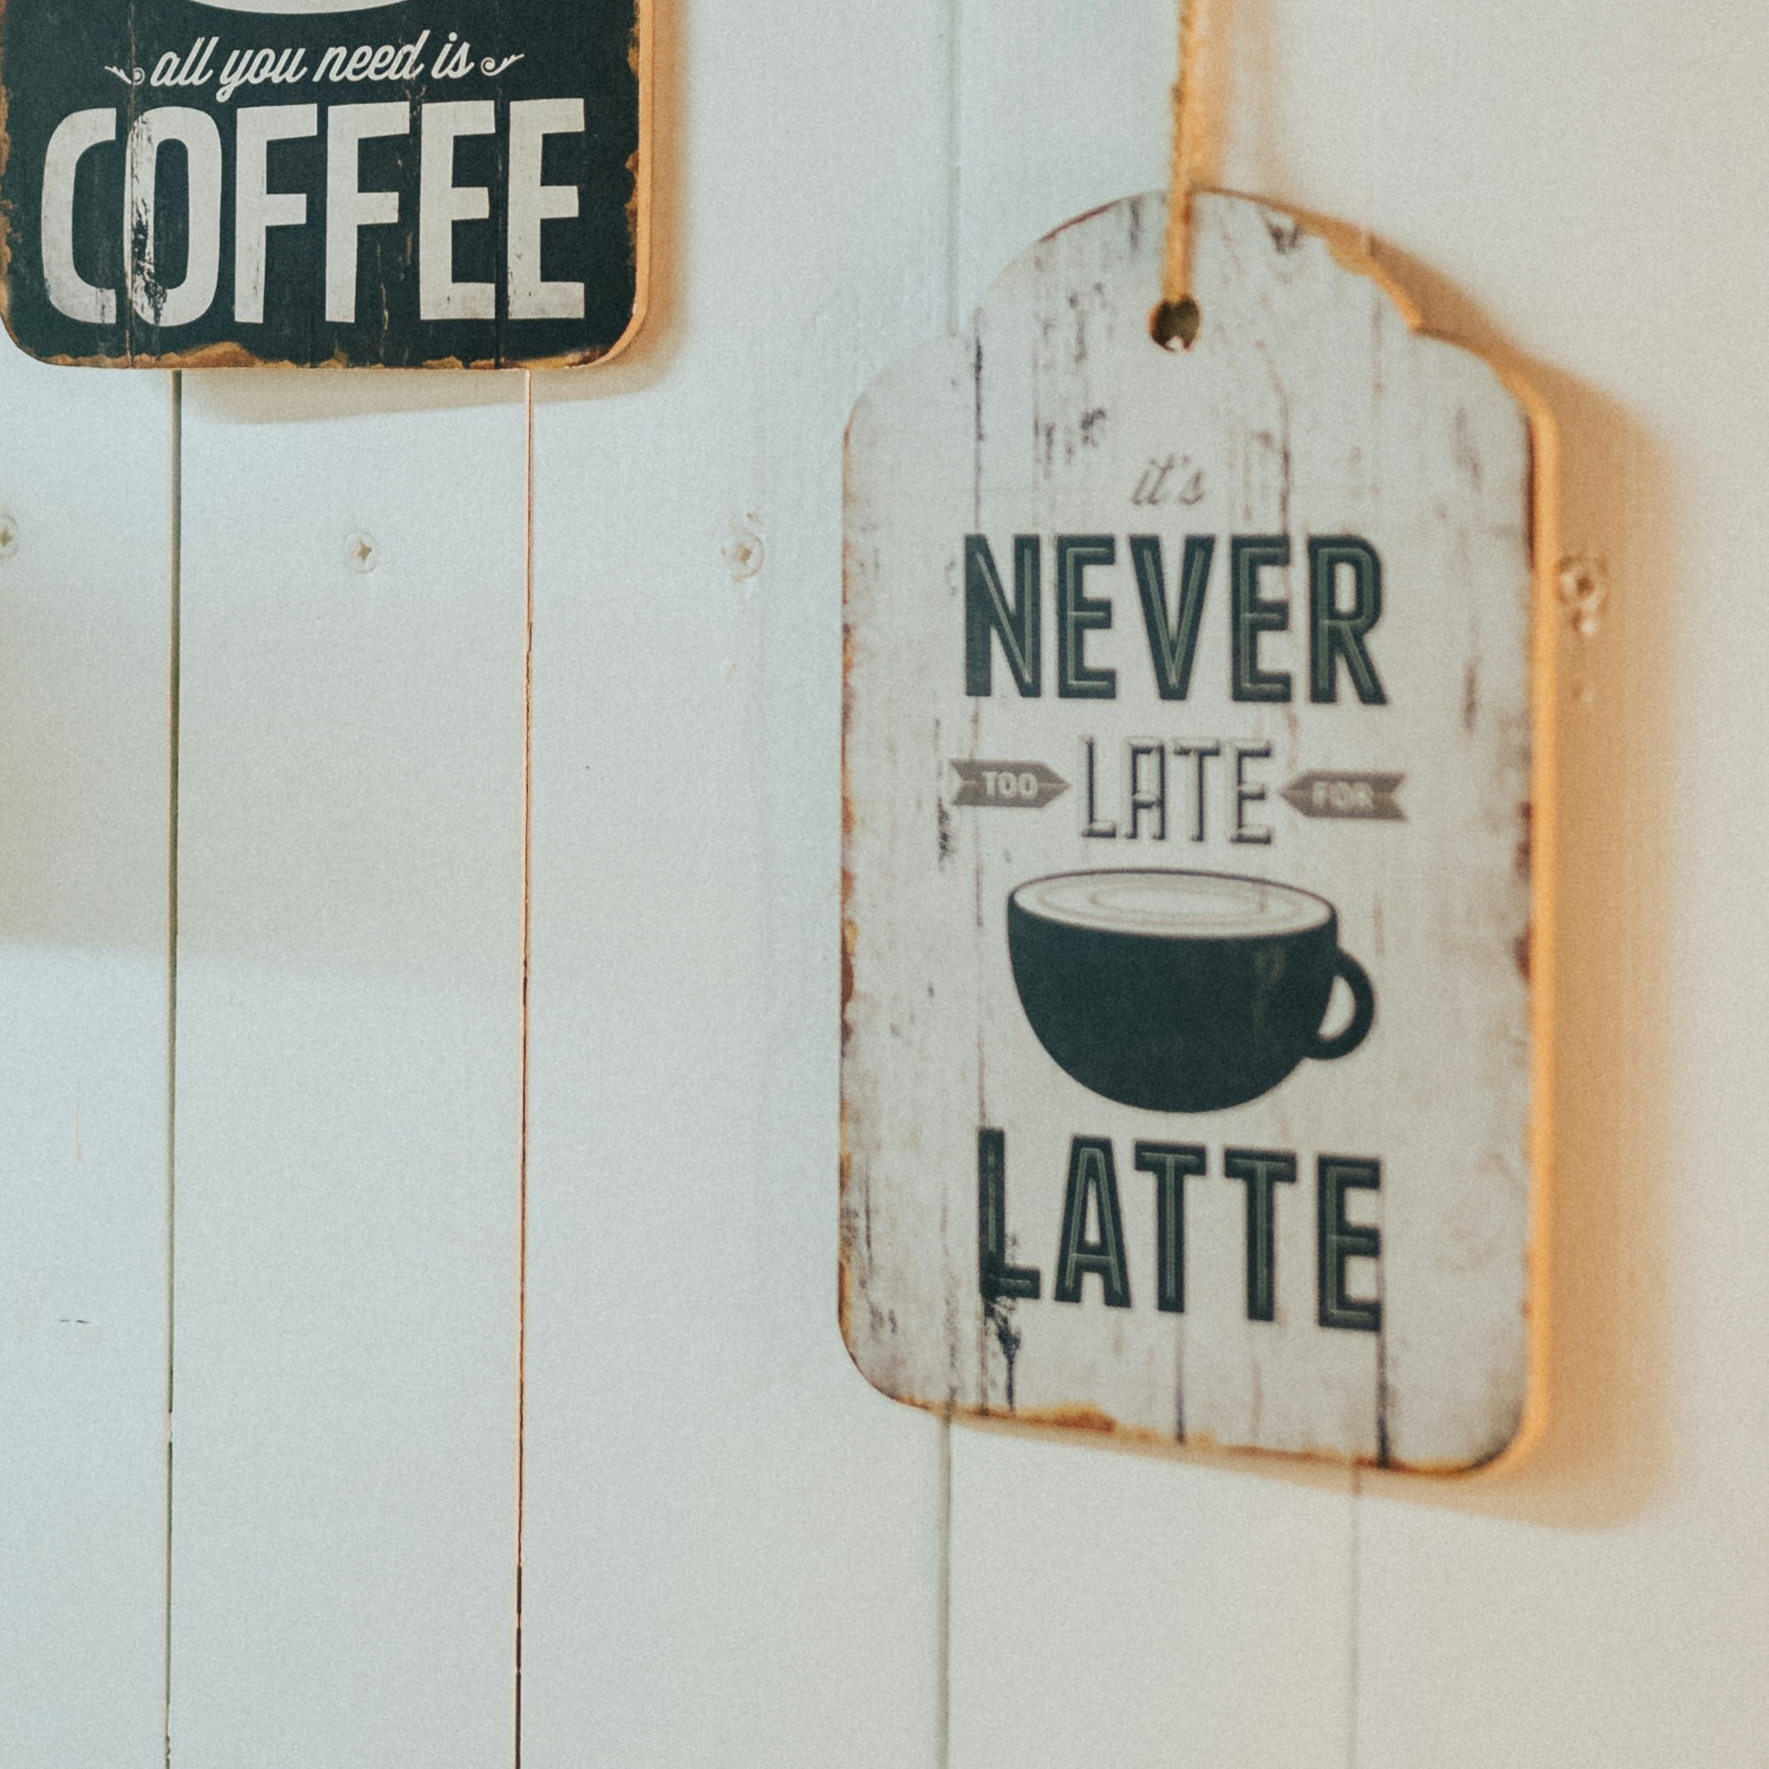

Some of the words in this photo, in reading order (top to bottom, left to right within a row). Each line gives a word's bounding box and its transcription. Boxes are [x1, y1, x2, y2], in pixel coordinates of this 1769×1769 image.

[150, 35, 219, 88] all
[214, 45, 308, 103] you
[312, 29, 431, 84] need
[430, 31, 475, 80] is
[41, 98, 586, 327] COFFEE
[1131, 454, 1206, 506] it's
[964, 533, 1389, 706] NEVER
[982, 770, 1039, 800] TOO
[1080, 736, 1272, 845] LATE
[1310, 782, 1375, 810] FOR
[977, 1127, 1382, 1332] LATTE
